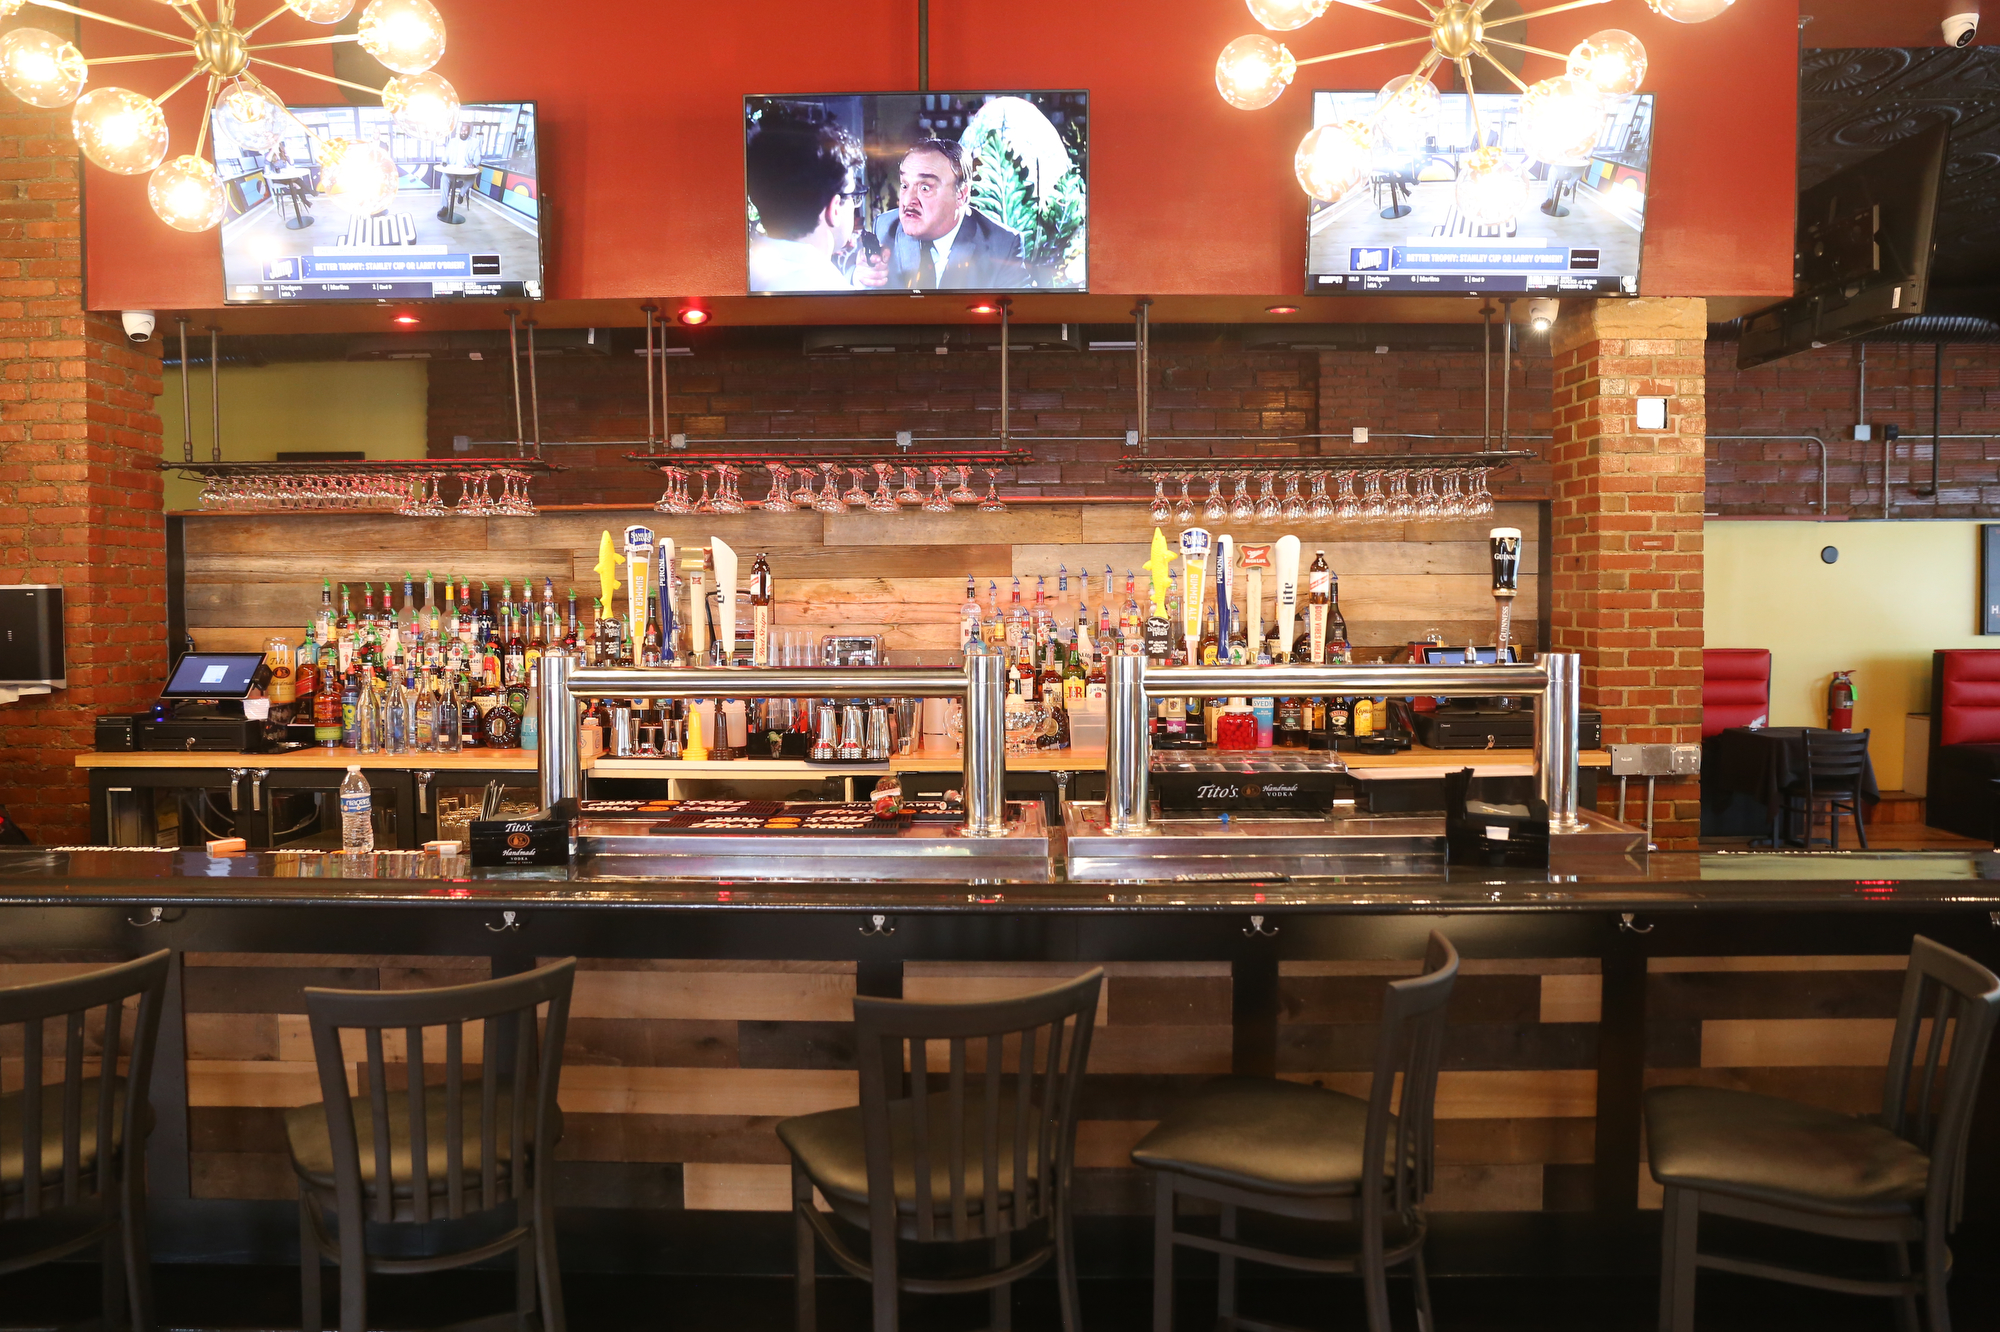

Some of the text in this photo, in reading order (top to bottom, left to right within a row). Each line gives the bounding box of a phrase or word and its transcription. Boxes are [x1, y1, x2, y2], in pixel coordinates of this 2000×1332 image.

[315, 262, 338, 271] BETTER
[365, 262, 391, 271] STANLEY
[392, 262, 405, 270] CUP
[406, 261, 416, 270] OR
[416, 261, 437, 270] LARRY
[1406, 254, 1430, 263] BETTER
[1431, 254, 1458, 263] TROPHY:
[1459, 254, 1487, 263] STANLEY
[1488, 254, 1501, 263] CUP
[1502, 254, 1512, 263] OR
[1512, 254, 1534, 263] LARRY
[635, 576, 644, 622] SUMMER ALE
[1188, 574, 1198, 621] SUMMER ALE
[1314, 606, 1323, 621] GOOD
[759, 612, 767, 638] Stripe
[1314, 622, 1322, 639] VIBES
[1499, 606, 1509, 641] GUINNESS
[1262, 783, 1298, 792] Handmade
[502, 847, 536, 857] Handmade
